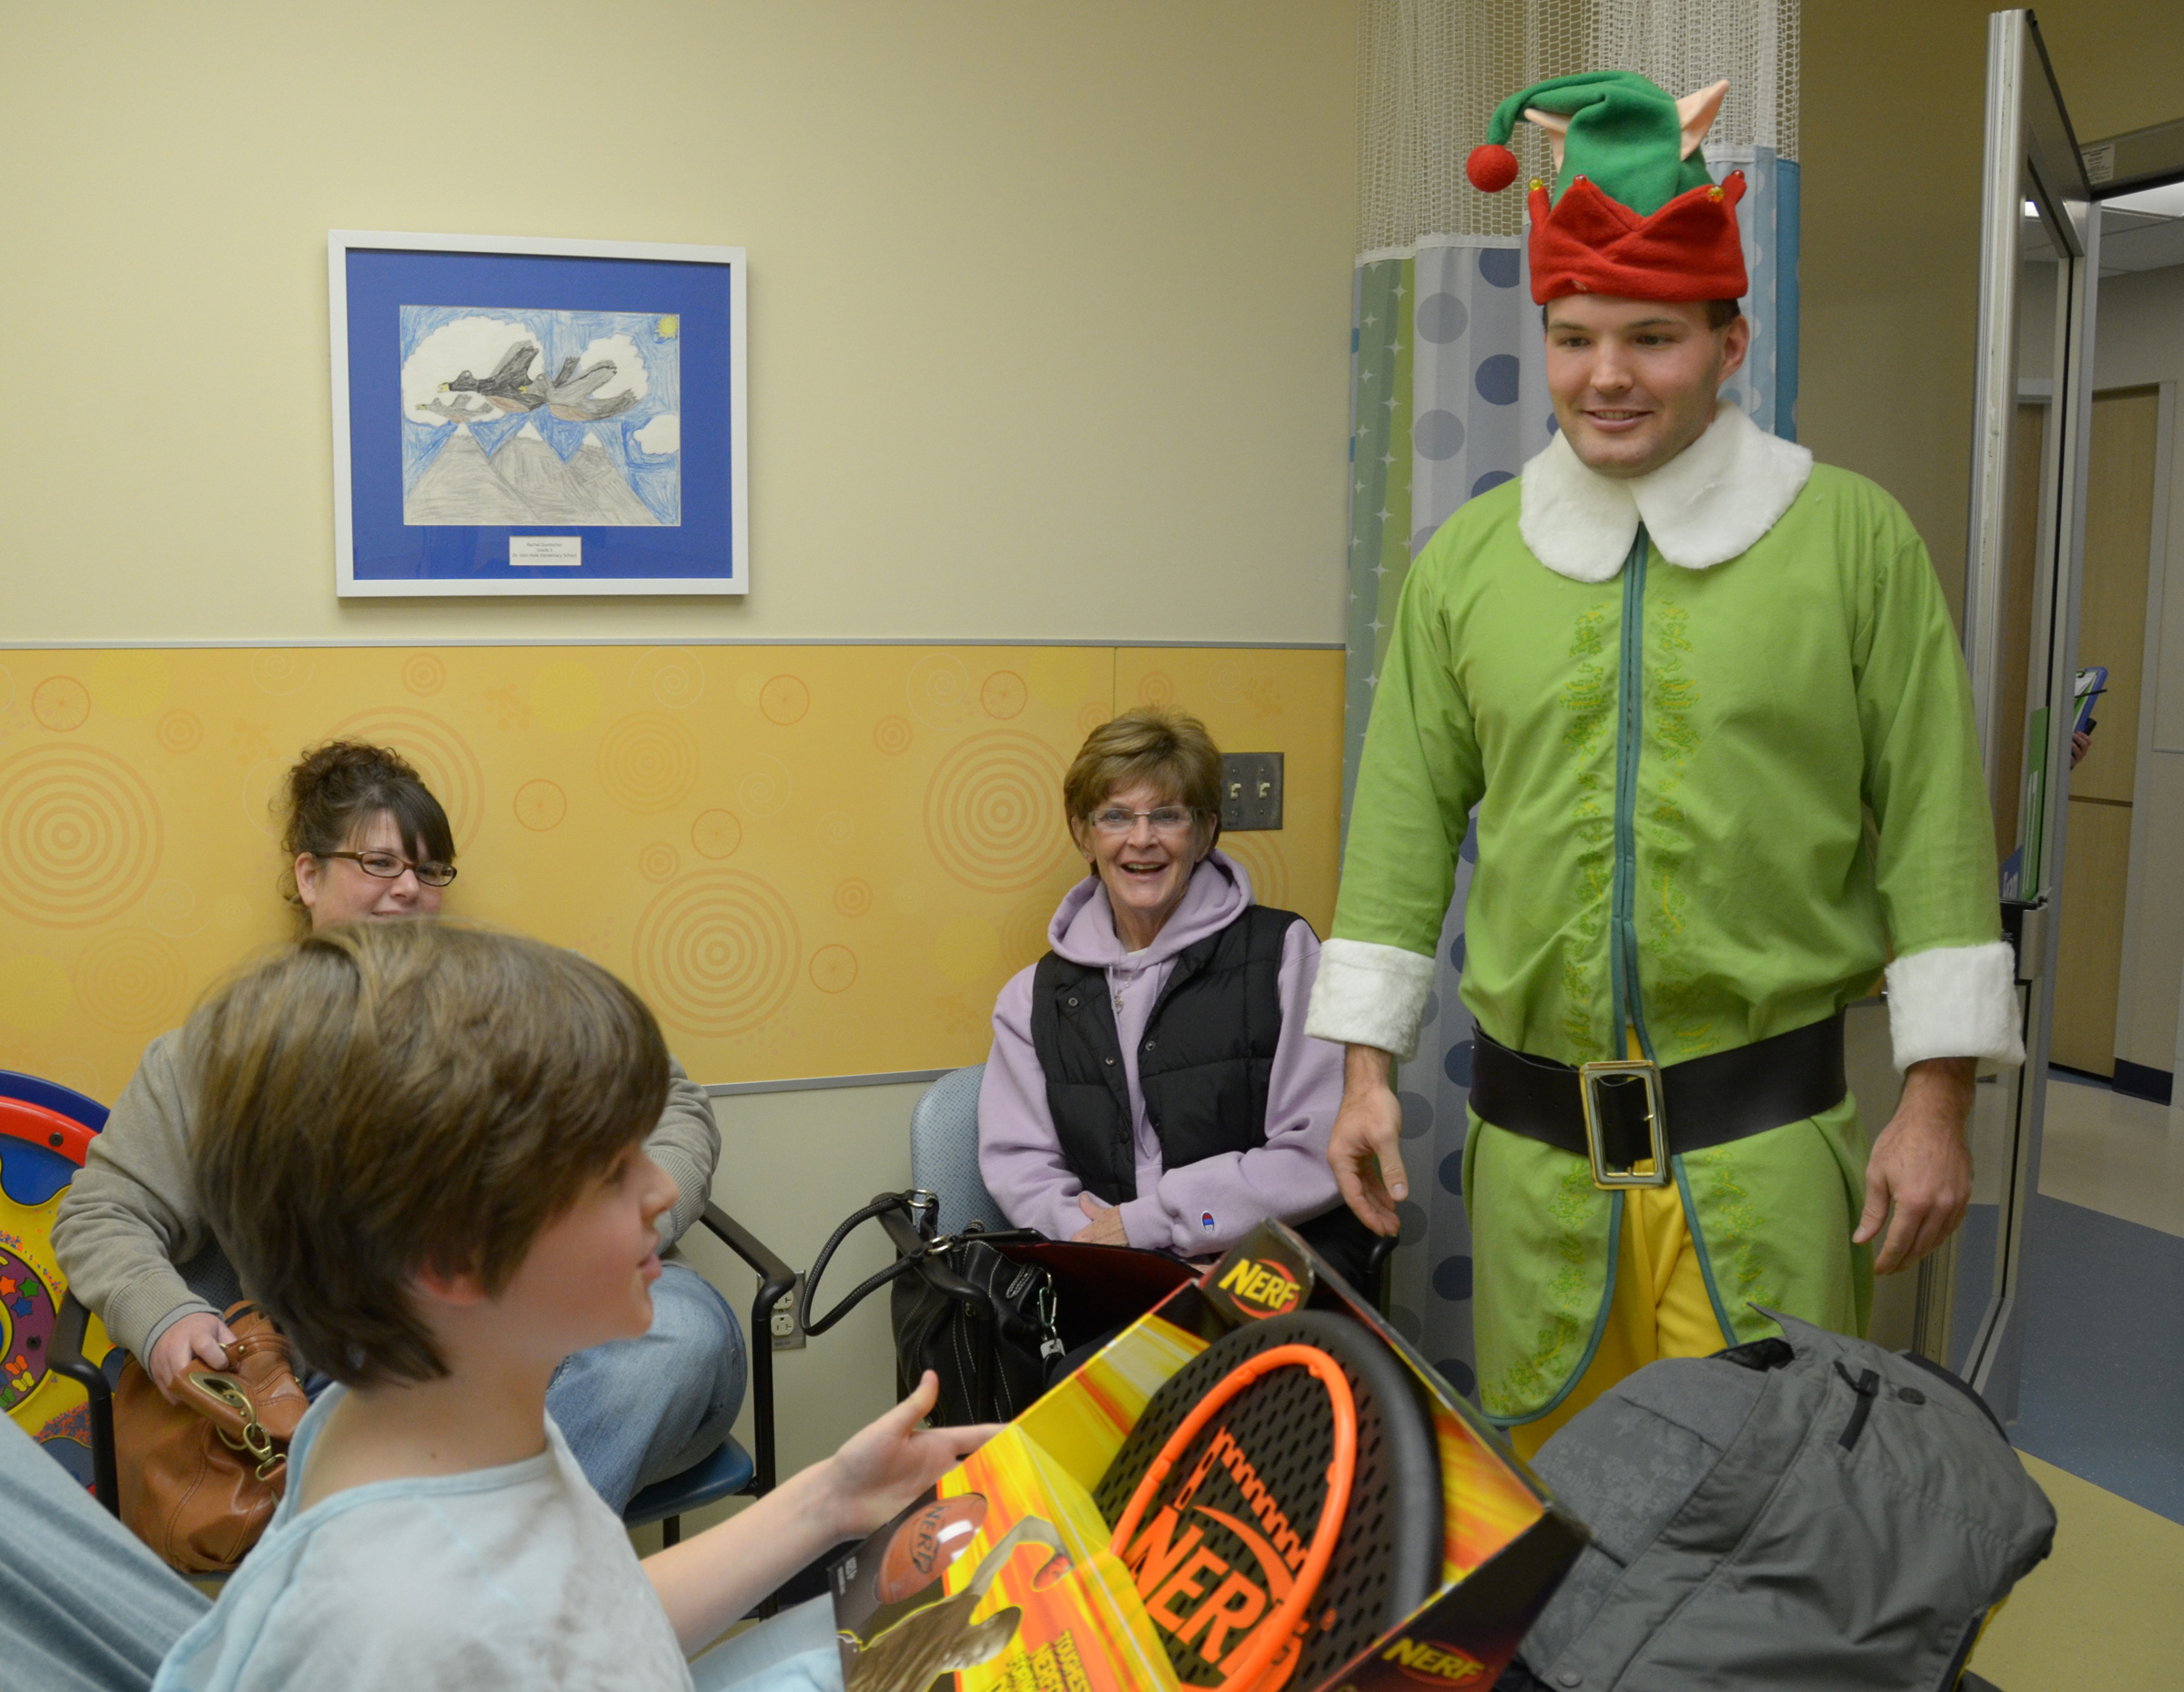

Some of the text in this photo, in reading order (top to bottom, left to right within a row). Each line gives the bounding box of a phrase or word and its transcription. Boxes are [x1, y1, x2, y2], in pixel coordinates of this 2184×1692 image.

[1218, 1258, 1301, 1310] NERF
[916, 1505, 945, 1565] NERF
[1054, 1628, 1093, 1692] TOUGHES
[1381, 1637, 1485, 1679] NERF
